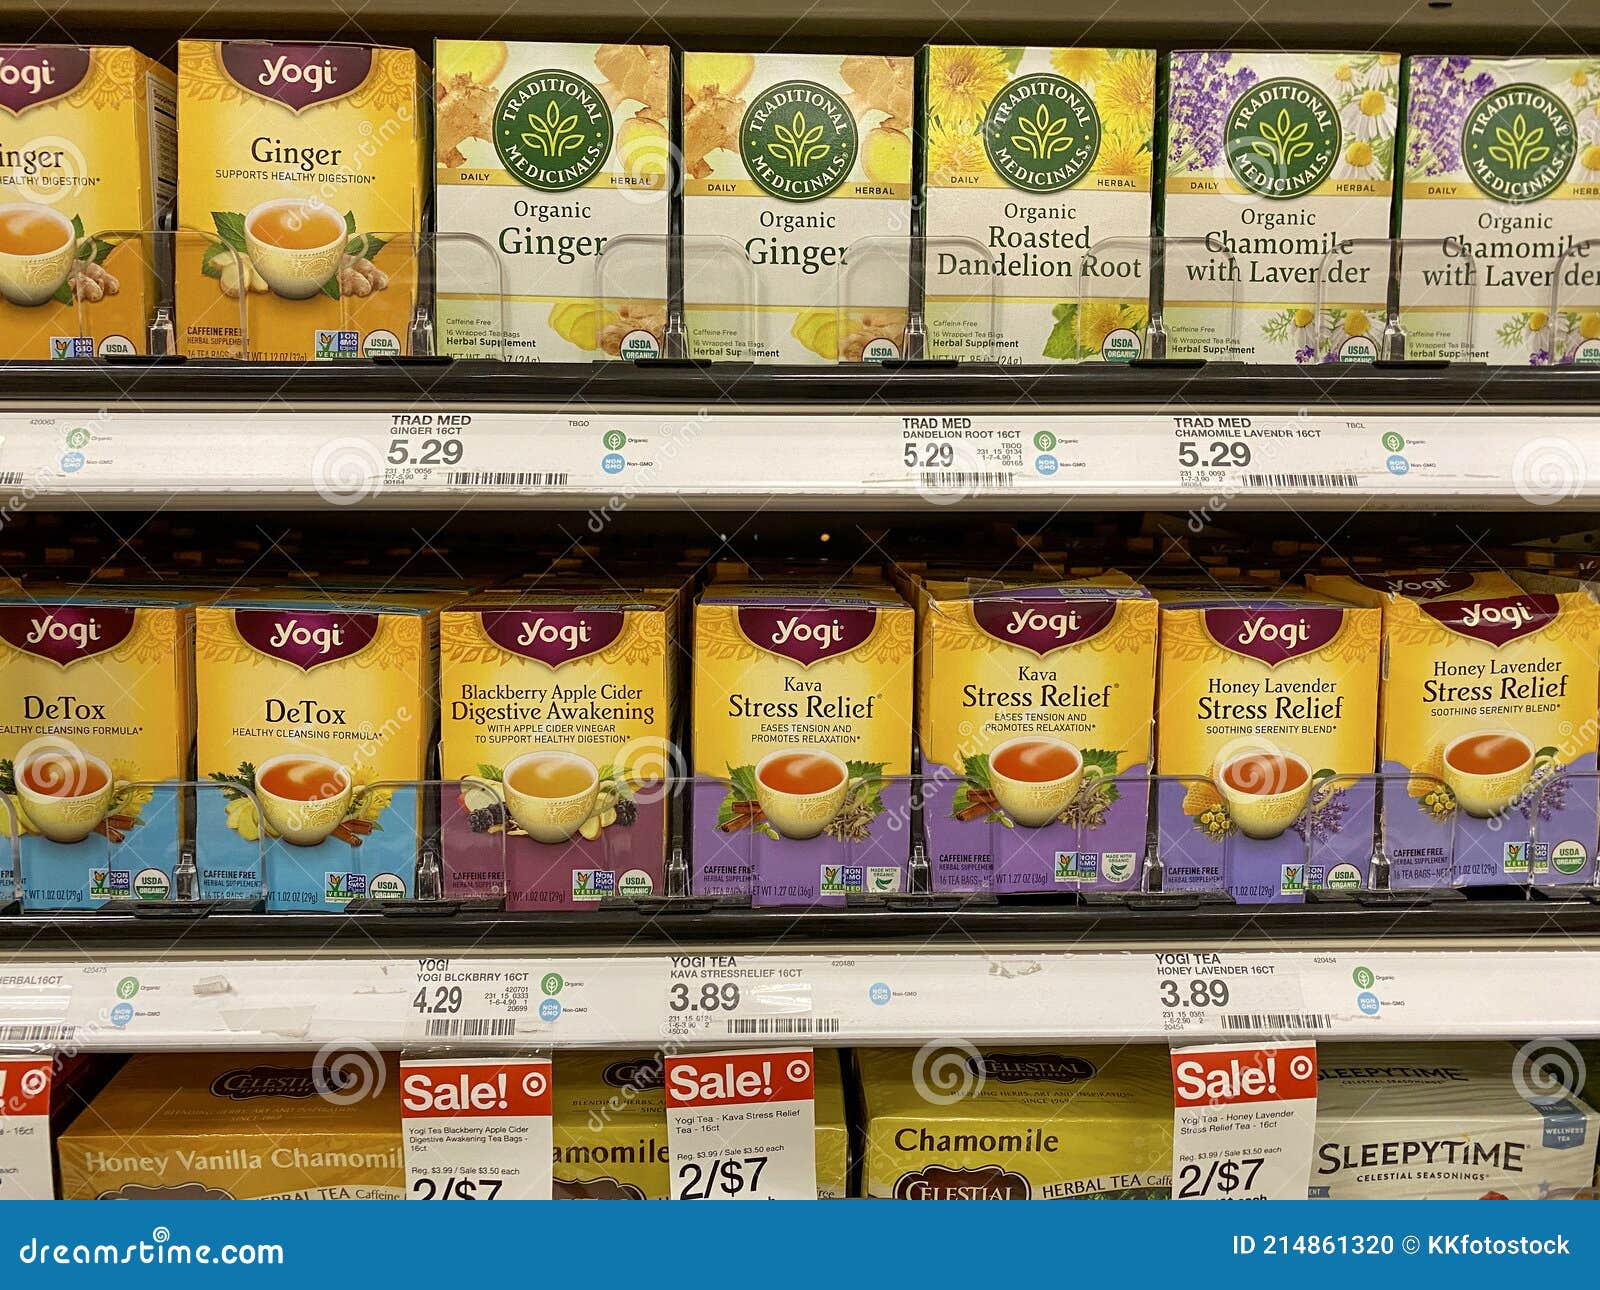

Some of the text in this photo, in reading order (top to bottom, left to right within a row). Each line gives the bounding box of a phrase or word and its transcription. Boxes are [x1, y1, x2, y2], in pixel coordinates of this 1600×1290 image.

[503, 79, 602, 124] TRADITIONAL
[750, 90, 848, 135] TRADITIONAL
[994, 83, 1090, 127] TRADITIONAL
[1235, 87, 1331, 132] TRADITIONAL
[0, 143, 64, 173] inger
[251, 137, 342, 171] Ginger
[506, 144, 601, 184] MEDICINALS
[215, 169, 268, 180] SUPPORTS
[271, 171, 315, 183] HEALTHY
[752, 154, 846, 193] MEDICINALS
[996, 147, 1088, 185] MEDICINALS
[1236, 153, 1328, 192] MEDICINALS
[611, 177, 650, 185] HERBAL
[856, 187, 895, 195] HERBAL
[1097, 179, 1136, 187] HERBAL
[1337, 184, 1375, 192] HERBAL
[514, 201, 591, 222] Organic
[760, 211, 836, 232] Organic
[1005, 203, 1076, 223] Organic
[1241, 209, 1316, 229] Organic
[1478, 213, 1552, 233] Organic
[499, 227, 607, 264] Ginger
[989, 226, 1091, 248] Roasted
[1205, 230, 1353, 255] Chamomile
[745, 238, 850, 274] Ginger
[938, 253, 1141, 278] Dandelion Root
[1186, 259, 1241, 281] with
[455, 330, 487, 338] Wrapped
[629, 340, 651, 349] USDA
[1111, 339, 1133, 347] USDA
[392, 415, 471, 425] TRAD MED
[436, 427, 462, 435] 16CT
[903, 418, 971, 428] TRAD MED
[1174, 418, 1251, 427] TRAD MED
[1175, 430, 1321, 438] CHAMOMILE LAVENDR 16CT
[387, 439, 464, 465] 5.29
[904, 443, 954, 467] 5.29
[1178, 442, 1251, 467] 5.29
[1018, 667, 1056, 681] Kava
[1434, 658, 1562, 678] Honey Lavender
[462, 685, 642, 703] Blackberry Apple Cider
[784, 677, 822, 692] Kava
[1209, 678, 1336, 696] Honey Lavender
[1423, 675, 1569, 702] Stress Relief
[729, 694, 875, 718] Stress Relief
[963, 685, 1112, 707] Stress Relief
[24, 696, 105, 721] DeTox
[265, 699, 346, 724] DeTox
[452, 702, 654, 725] Digestive Awakening
[1198, 696, 1344, 719] Stress Relief
[232, 728, 274, 737] HEALTHY
[276, 729, 329, 740] CLEANSING
[475, 735, 486, 743] TO
[489, 735, 532, 743] SUPPORT
[546, 725, 573, 733] CIDER
[576, 725, 615, 733] VINEGAR
[204, 870, 256, 879] CAFFEINE FREE
[418, 960, 449, 971] YOGI
[671, 957, 737, 967] YOGI TEA
[1155, 954, 1221, 964] YOGI TEA
[417, 973, 528, 982] YOGI BLCKBRRY 16CT
[670, 969, 802, 978] KAVA STRESSRELIEF 16CT
[1157, 967, 1192, 975] HONEY
[1251, 966, 1275, 974] 16CT
[413, 986, 462, 1013] 4.29
[670, 983, 740, 1011] 3.89
[1160, 979, 1229, 1007] 3.89
[670, 1062, 773, 1101] Sale!
[1176, 1058, 1276, 1100] Sale!
[403, 1073, 508, 1112] Sale!
[1256, 1110, 1294, 1119] Lavender
[895, 1128, 1059, 1153] Chamomile
[1546, 1127, 1584, 1135] WELLNESS
[86, 1149, 261, 1176] Honey Vanilla
[679, 1157, 768, 1200] 2/$7
[1043, 1174, 1141, 1199] HERBAL TEA
[1179, 1158, 1264, 1198] 2/$7
[1357, 1172, 1485, 1182] CELESTIAL SEASONINGS
